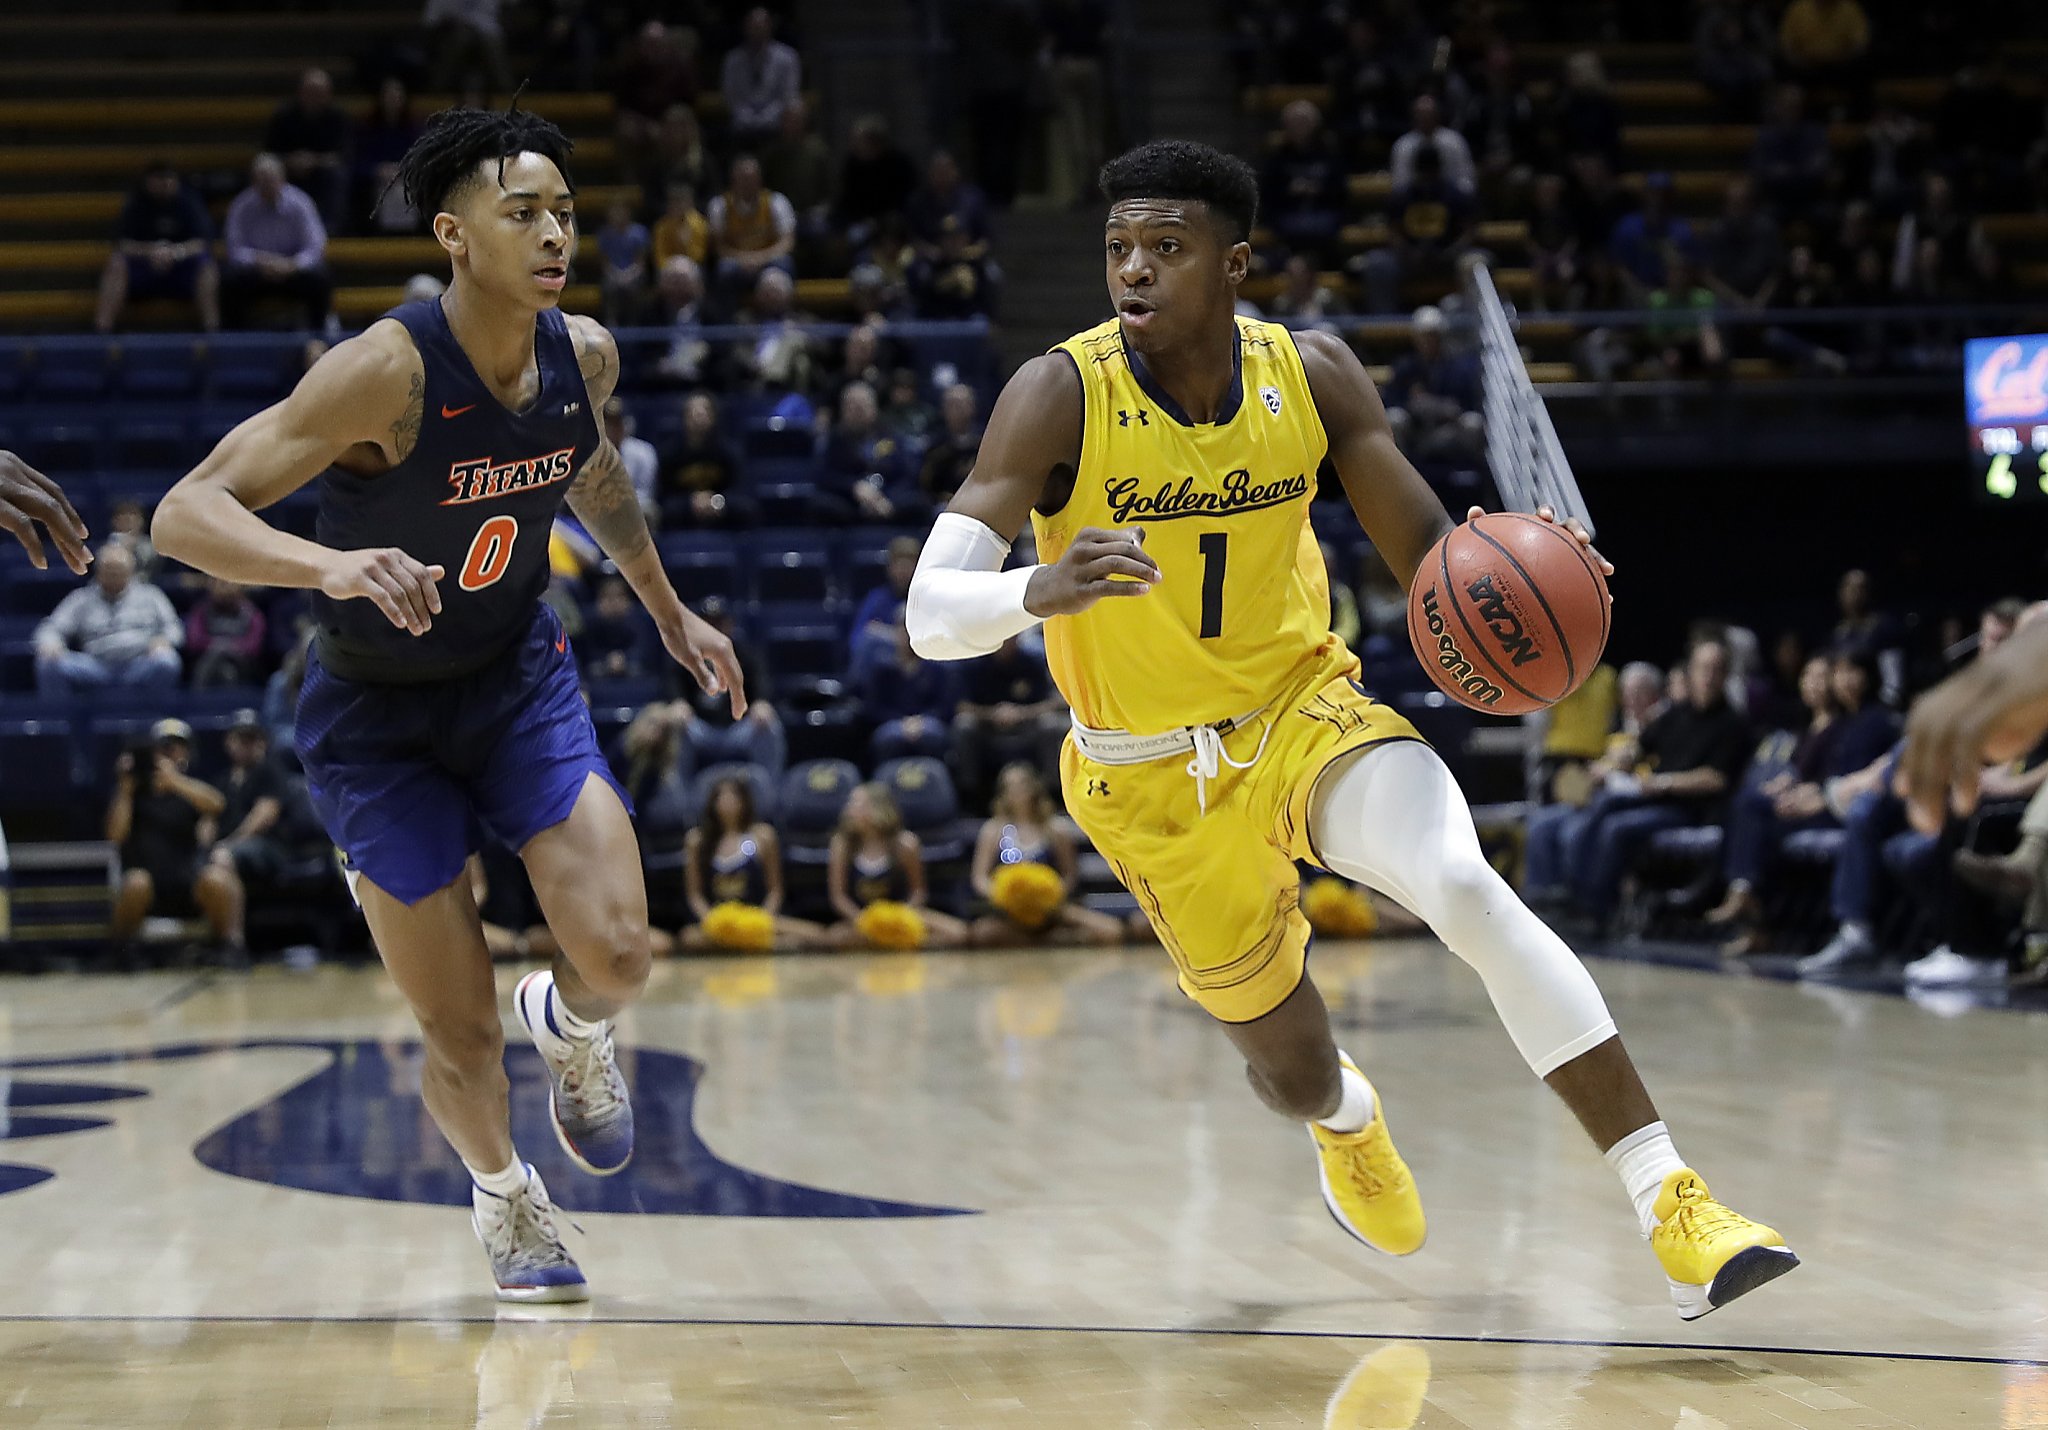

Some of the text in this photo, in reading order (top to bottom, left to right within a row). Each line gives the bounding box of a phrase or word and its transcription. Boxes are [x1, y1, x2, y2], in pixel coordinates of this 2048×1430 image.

[440, 448, 575, 504] TITANS
[1104, 468, 1308, 523] Golden Bears
[458, 515, 519, 592] 0
[1199, 533, 1228, 638] 1
[1423, 584, 1504, 705] Wilson
[1466, 575, 1541, 667] NCAA
[1676, 1179, 1695, 1199] Cl
